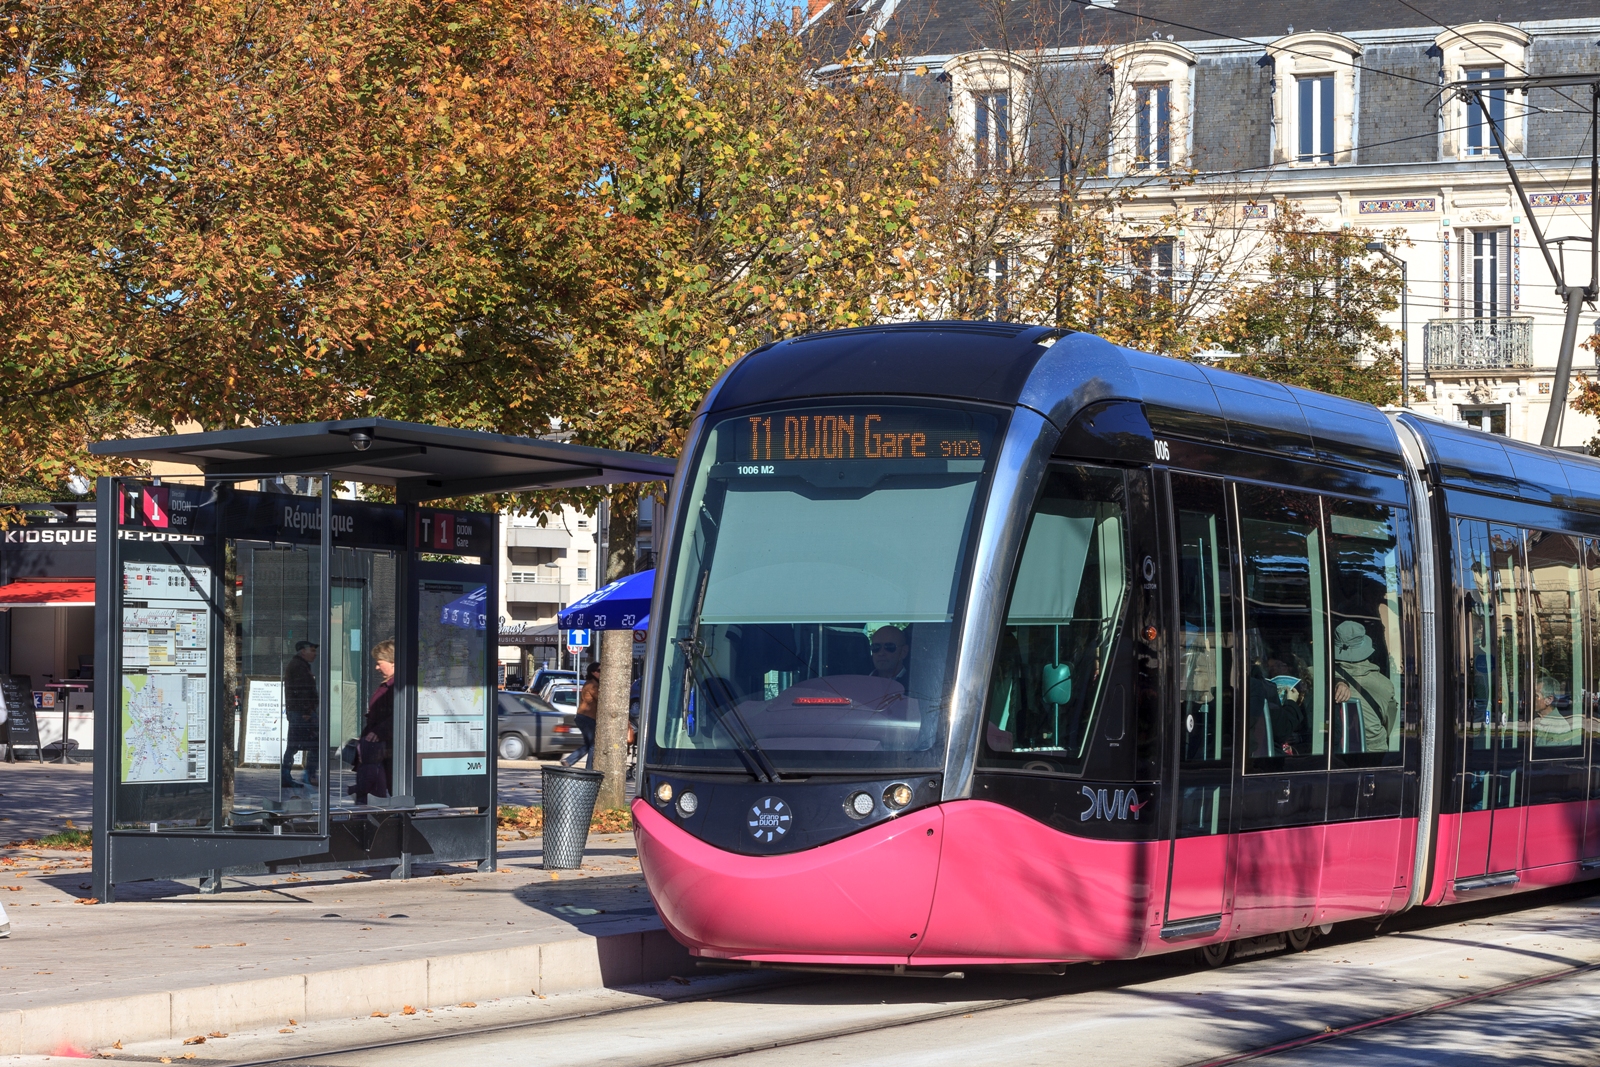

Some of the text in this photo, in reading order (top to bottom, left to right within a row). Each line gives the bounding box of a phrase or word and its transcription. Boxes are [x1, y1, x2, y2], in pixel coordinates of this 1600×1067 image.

[749, 414, 981, 460] T1 DIJON Gare 9109
[737, 465, 775, 475] 1006 M2
[128, 491, 160, 520] T 1
[171, 500, 191, 511] DIJON
[171, 513, 187, 525] Gare
[284, 505, 354, 537] Répubque
[5, 529, 97, 545] KIOSQUE
[421, 518, 447, 543] T 1
[456, 537, 469, 547] Gare
[594, 614, 606, 627] 20
[622, 614, 635, 626] 20
